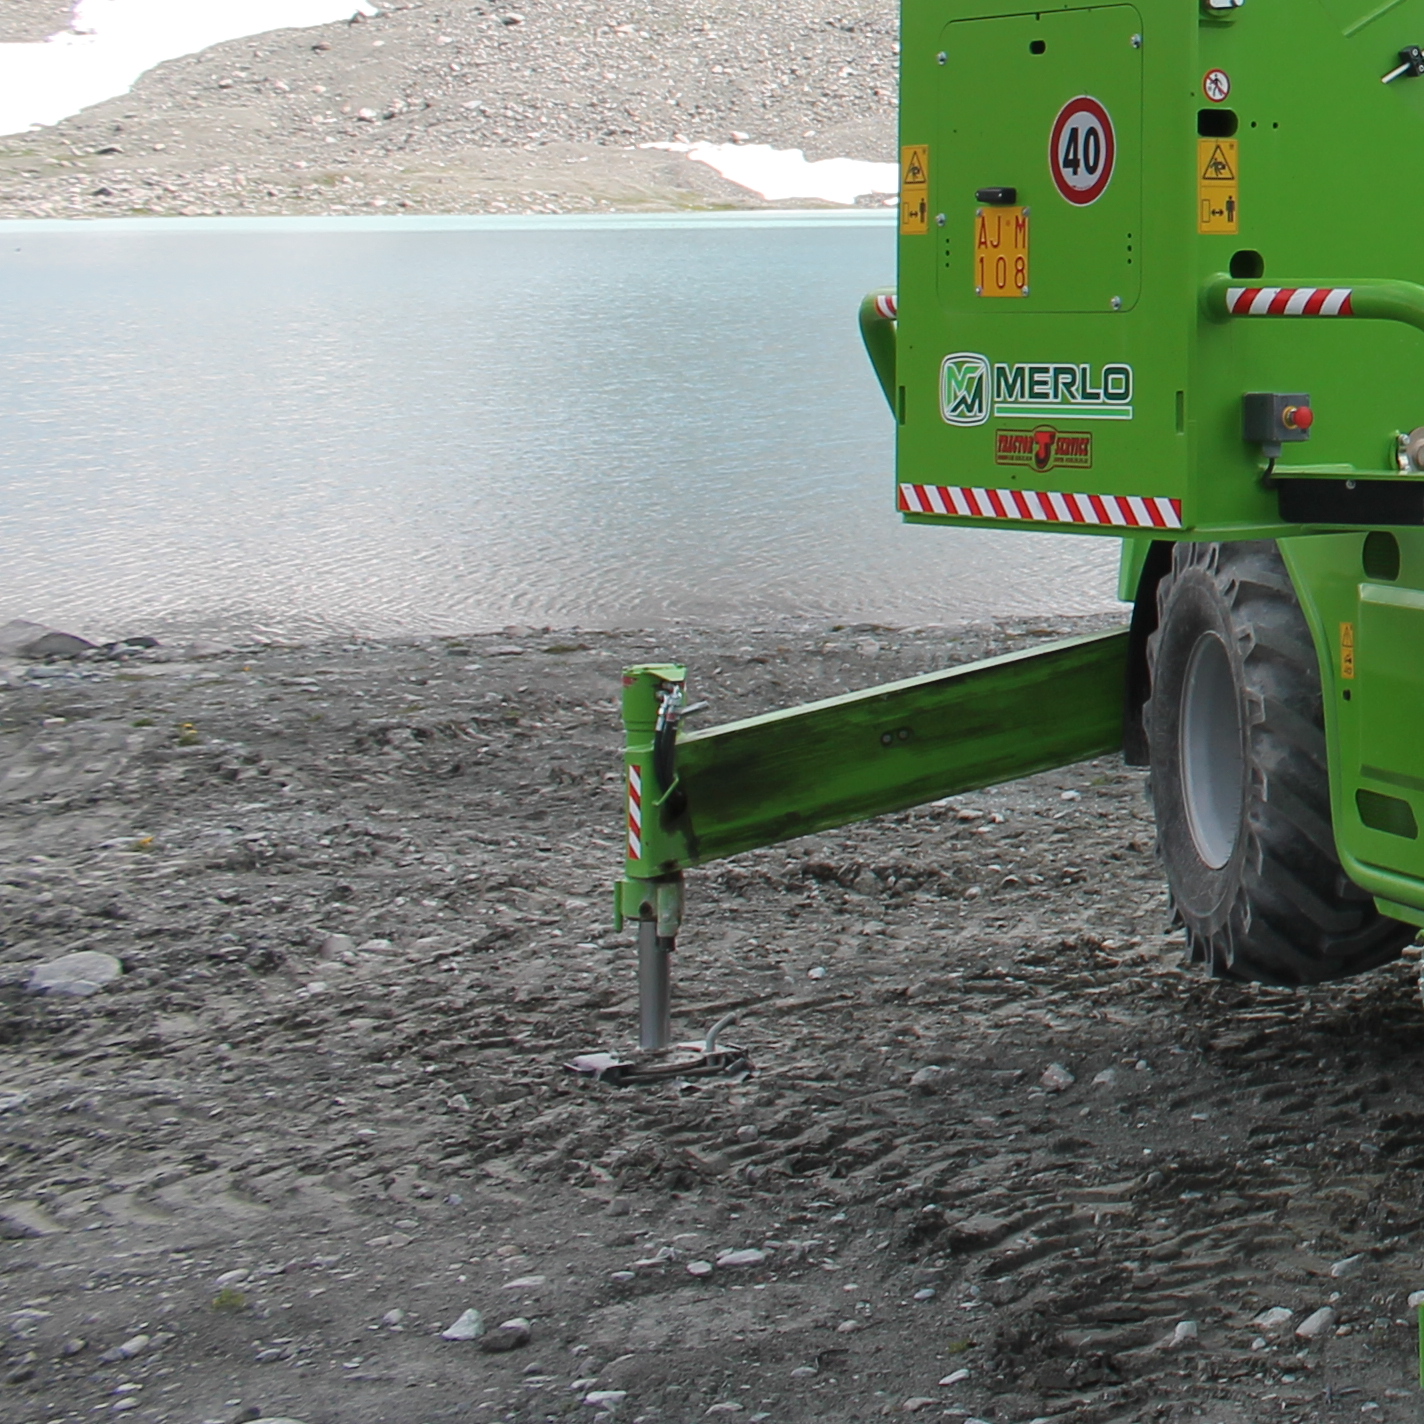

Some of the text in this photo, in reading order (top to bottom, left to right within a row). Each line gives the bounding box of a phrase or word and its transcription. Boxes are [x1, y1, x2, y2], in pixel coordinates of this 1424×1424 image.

[1062, 126, 1101, 176] 40
[978, 215, 1026, 250] AJ M
[979, 256, 1026, 290] 108
[994, 363, 1133, 404] MERLO
